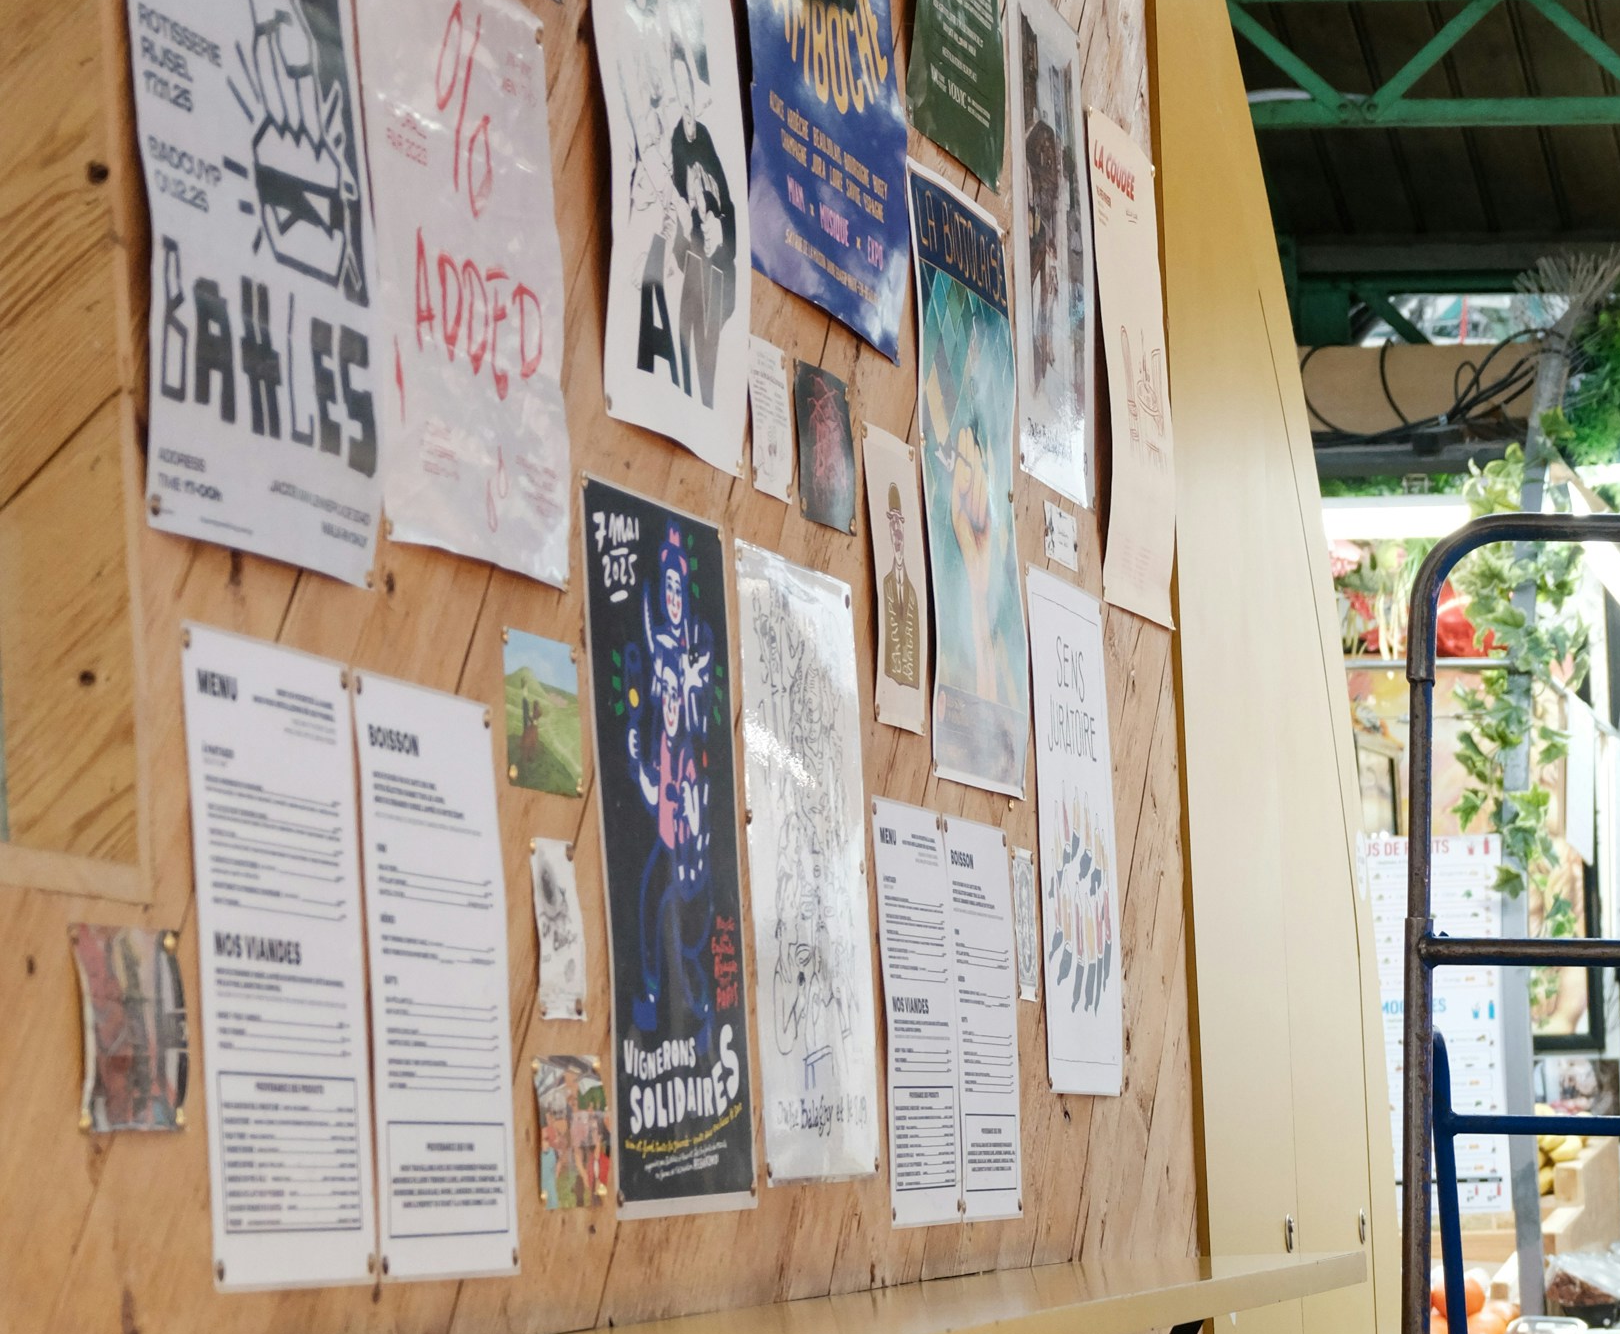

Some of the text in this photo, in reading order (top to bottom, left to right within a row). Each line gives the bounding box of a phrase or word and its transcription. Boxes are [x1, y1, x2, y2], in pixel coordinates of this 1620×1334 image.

[1093, 137, 1105, 175] LA
[819, 201, 850, 249] MUSIQUE
[867, 234, 884, 272] EXPO
[415, 225, 543, 402] ADDED
[593, 510, 606, 553] 7
[602, 553, 638, 588] 2025
[196, 668, 239, 702] MENU
[1055, 635, 1086, 705] SENS
[367, 723, 421, 758] BOISSON
[879, 826, 898, 849] MENU
[1383, 841, 1399, 857] DE
[950, 848, 975, 870] BOISSON
[213, 930, 302, 966] NOS VIANDES
[892, 995, 930, 1015] NOS VIANDES
[623, 1036, 697, 1081] VIGNERONS
[629, 1022, 740, 1136] SOLIDAIRES
